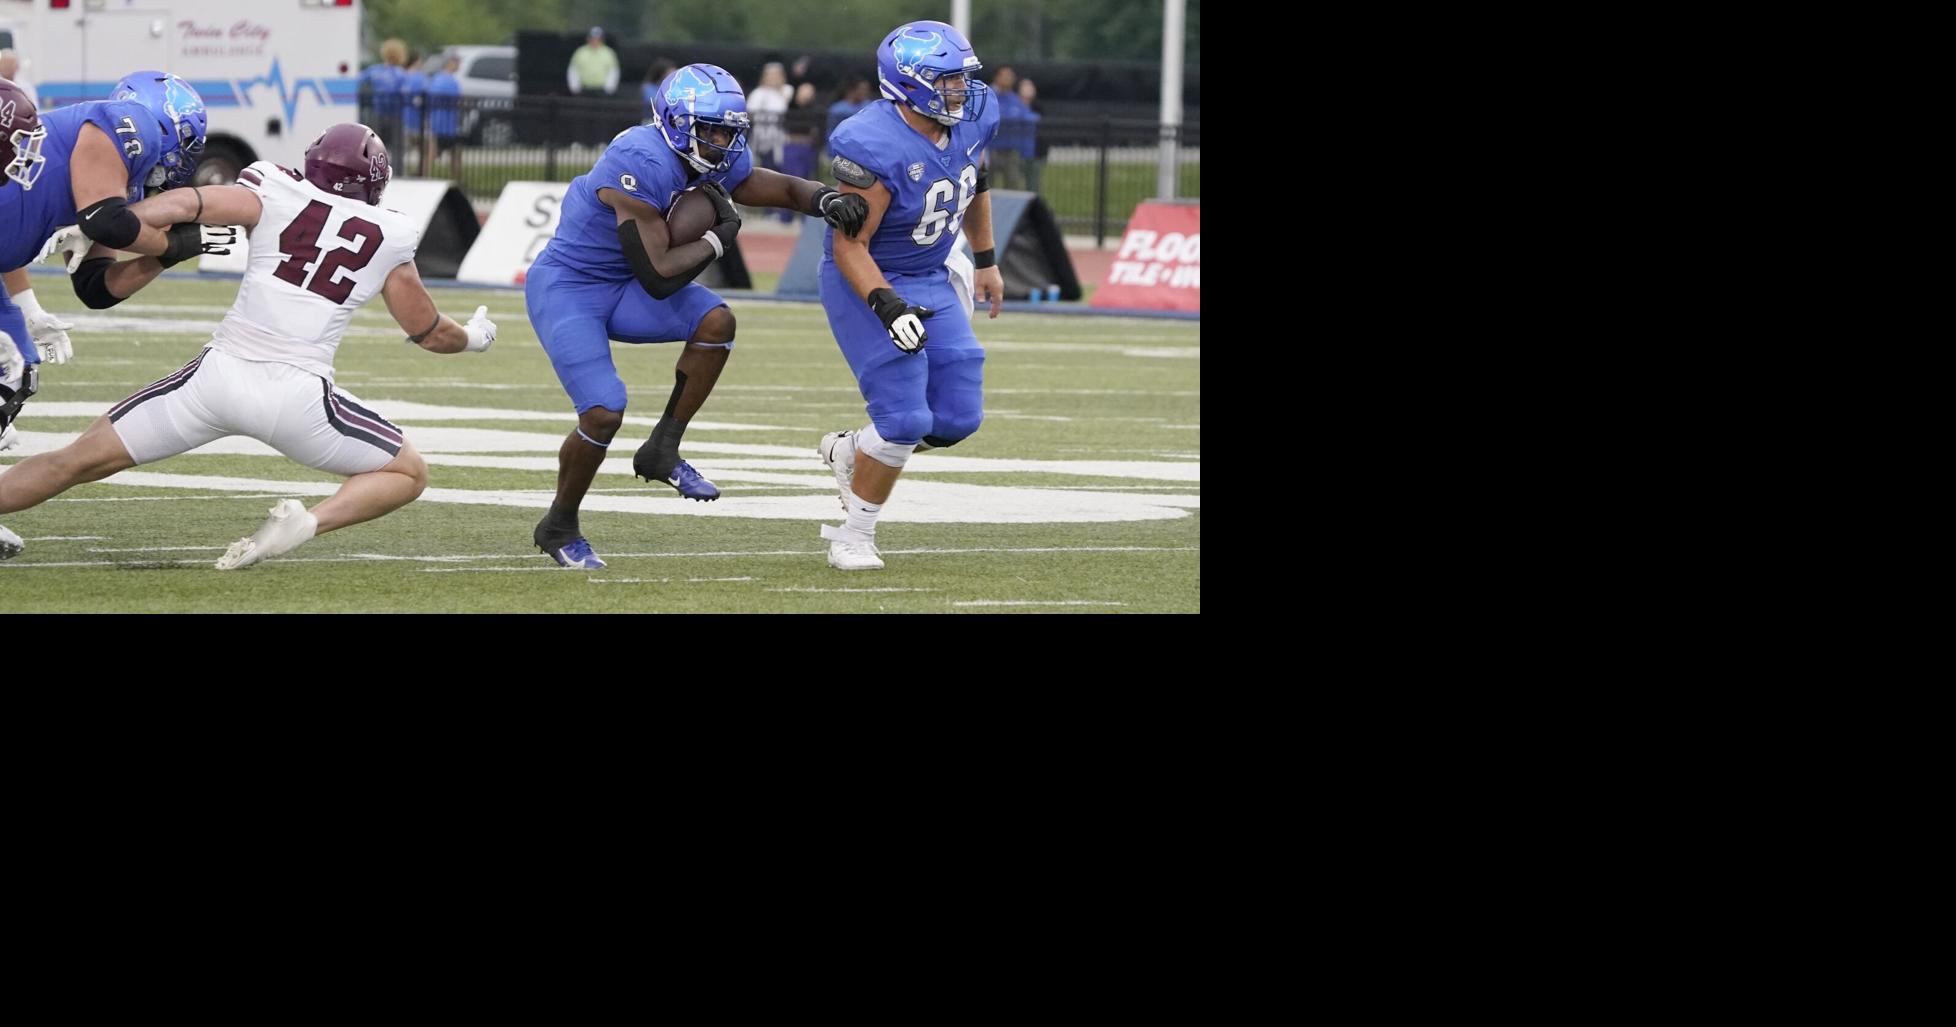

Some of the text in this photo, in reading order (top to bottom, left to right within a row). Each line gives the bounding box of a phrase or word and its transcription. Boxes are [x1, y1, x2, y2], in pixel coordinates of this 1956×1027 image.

[176, 18, 272, 41] Twin City
[0, 97, 16, 128] 4
[370, 152, 387, 182] 42
[332, 182, 344, 192] 42
[910, 162, 978, 246] 66
[273, 198, 384, 305] 42
